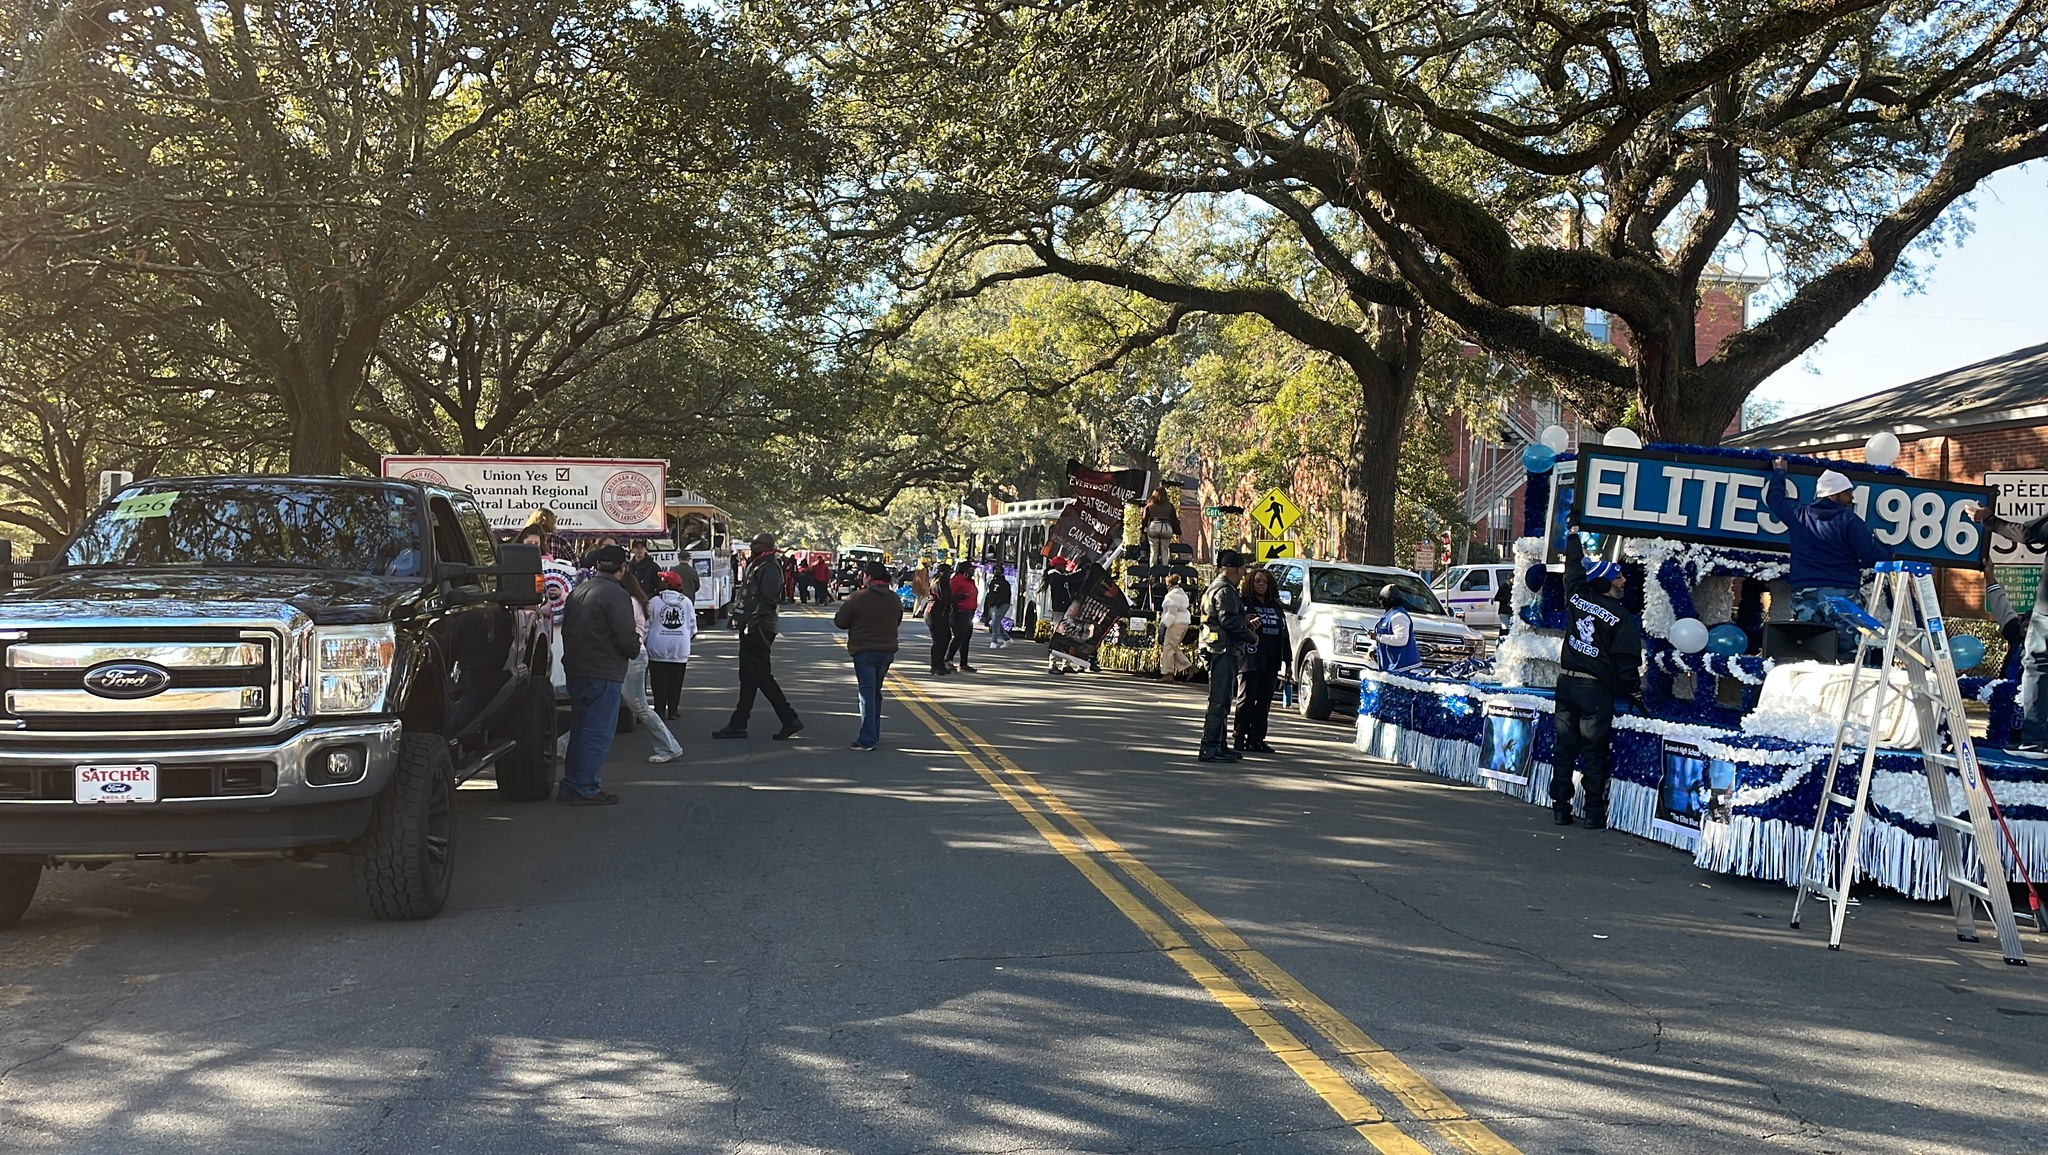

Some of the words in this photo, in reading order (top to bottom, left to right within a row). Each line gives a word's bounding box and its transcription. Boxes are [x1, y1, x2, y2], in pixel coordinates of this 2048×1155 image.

[482, 469, 521, 481] Union
[524, 470, 548, 481] Yes
[464, 484, 528, 496] Savannah
[531, 485, 589, 498] Regional
[121, 499, 166, 514] 126
[477, 498, 503, 509] tral
[507, 498, 545, 510] Labor
[549, 499, 599, 510] Council
[1997, 502, 2046, 516] LIMIT
[487, 515, 524, 526] gether
[556, 516, 583, 526] an...
[1068, 526, 1086, 542] CAN
[100, 668, 149, 687] Ford
[82, 770, 150, 782] SATCHER
[105, 784, 127, 793] Ford
